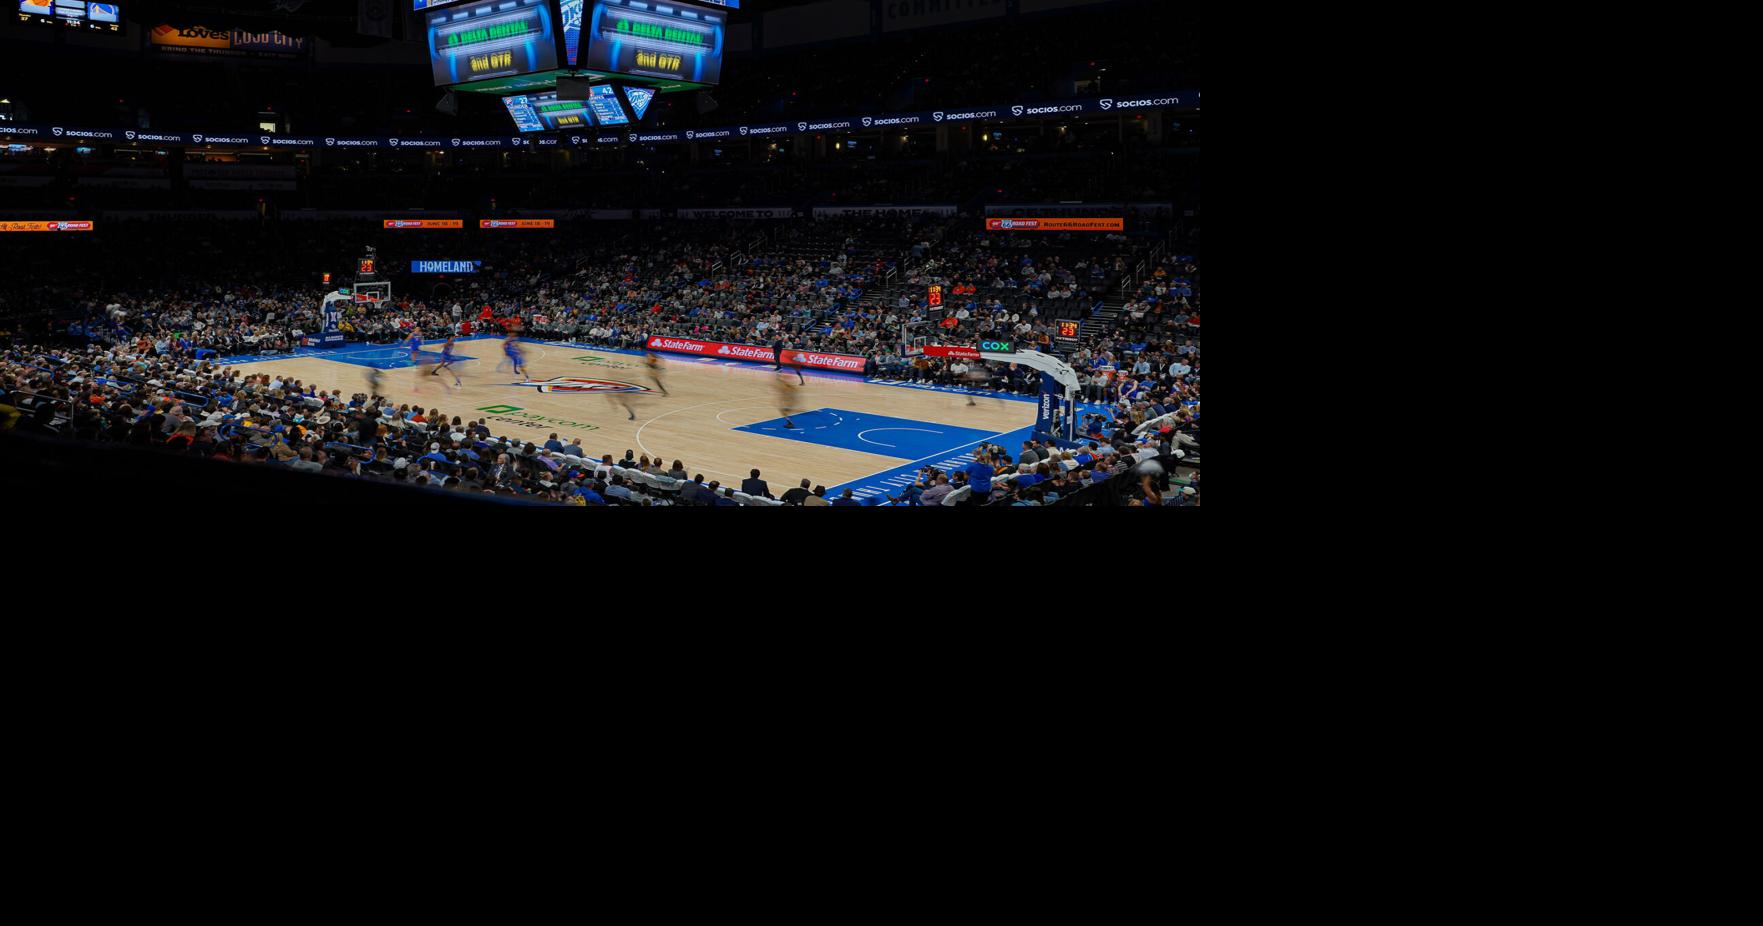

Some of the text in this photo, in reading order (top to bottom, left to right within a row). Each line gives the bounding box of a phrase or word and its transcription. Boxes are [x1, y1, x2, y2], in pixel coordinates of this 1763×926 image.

[692, 208, 774, 219] WELCOME TO
[419, 260, 474, 273] HOMELAND
[1061, 328, 1074, 336] 23
[982, 341, 1009, 351] COX
[807, 354, 859, 369] StateFarm
[1042, 393, 1051, 420] verizon
